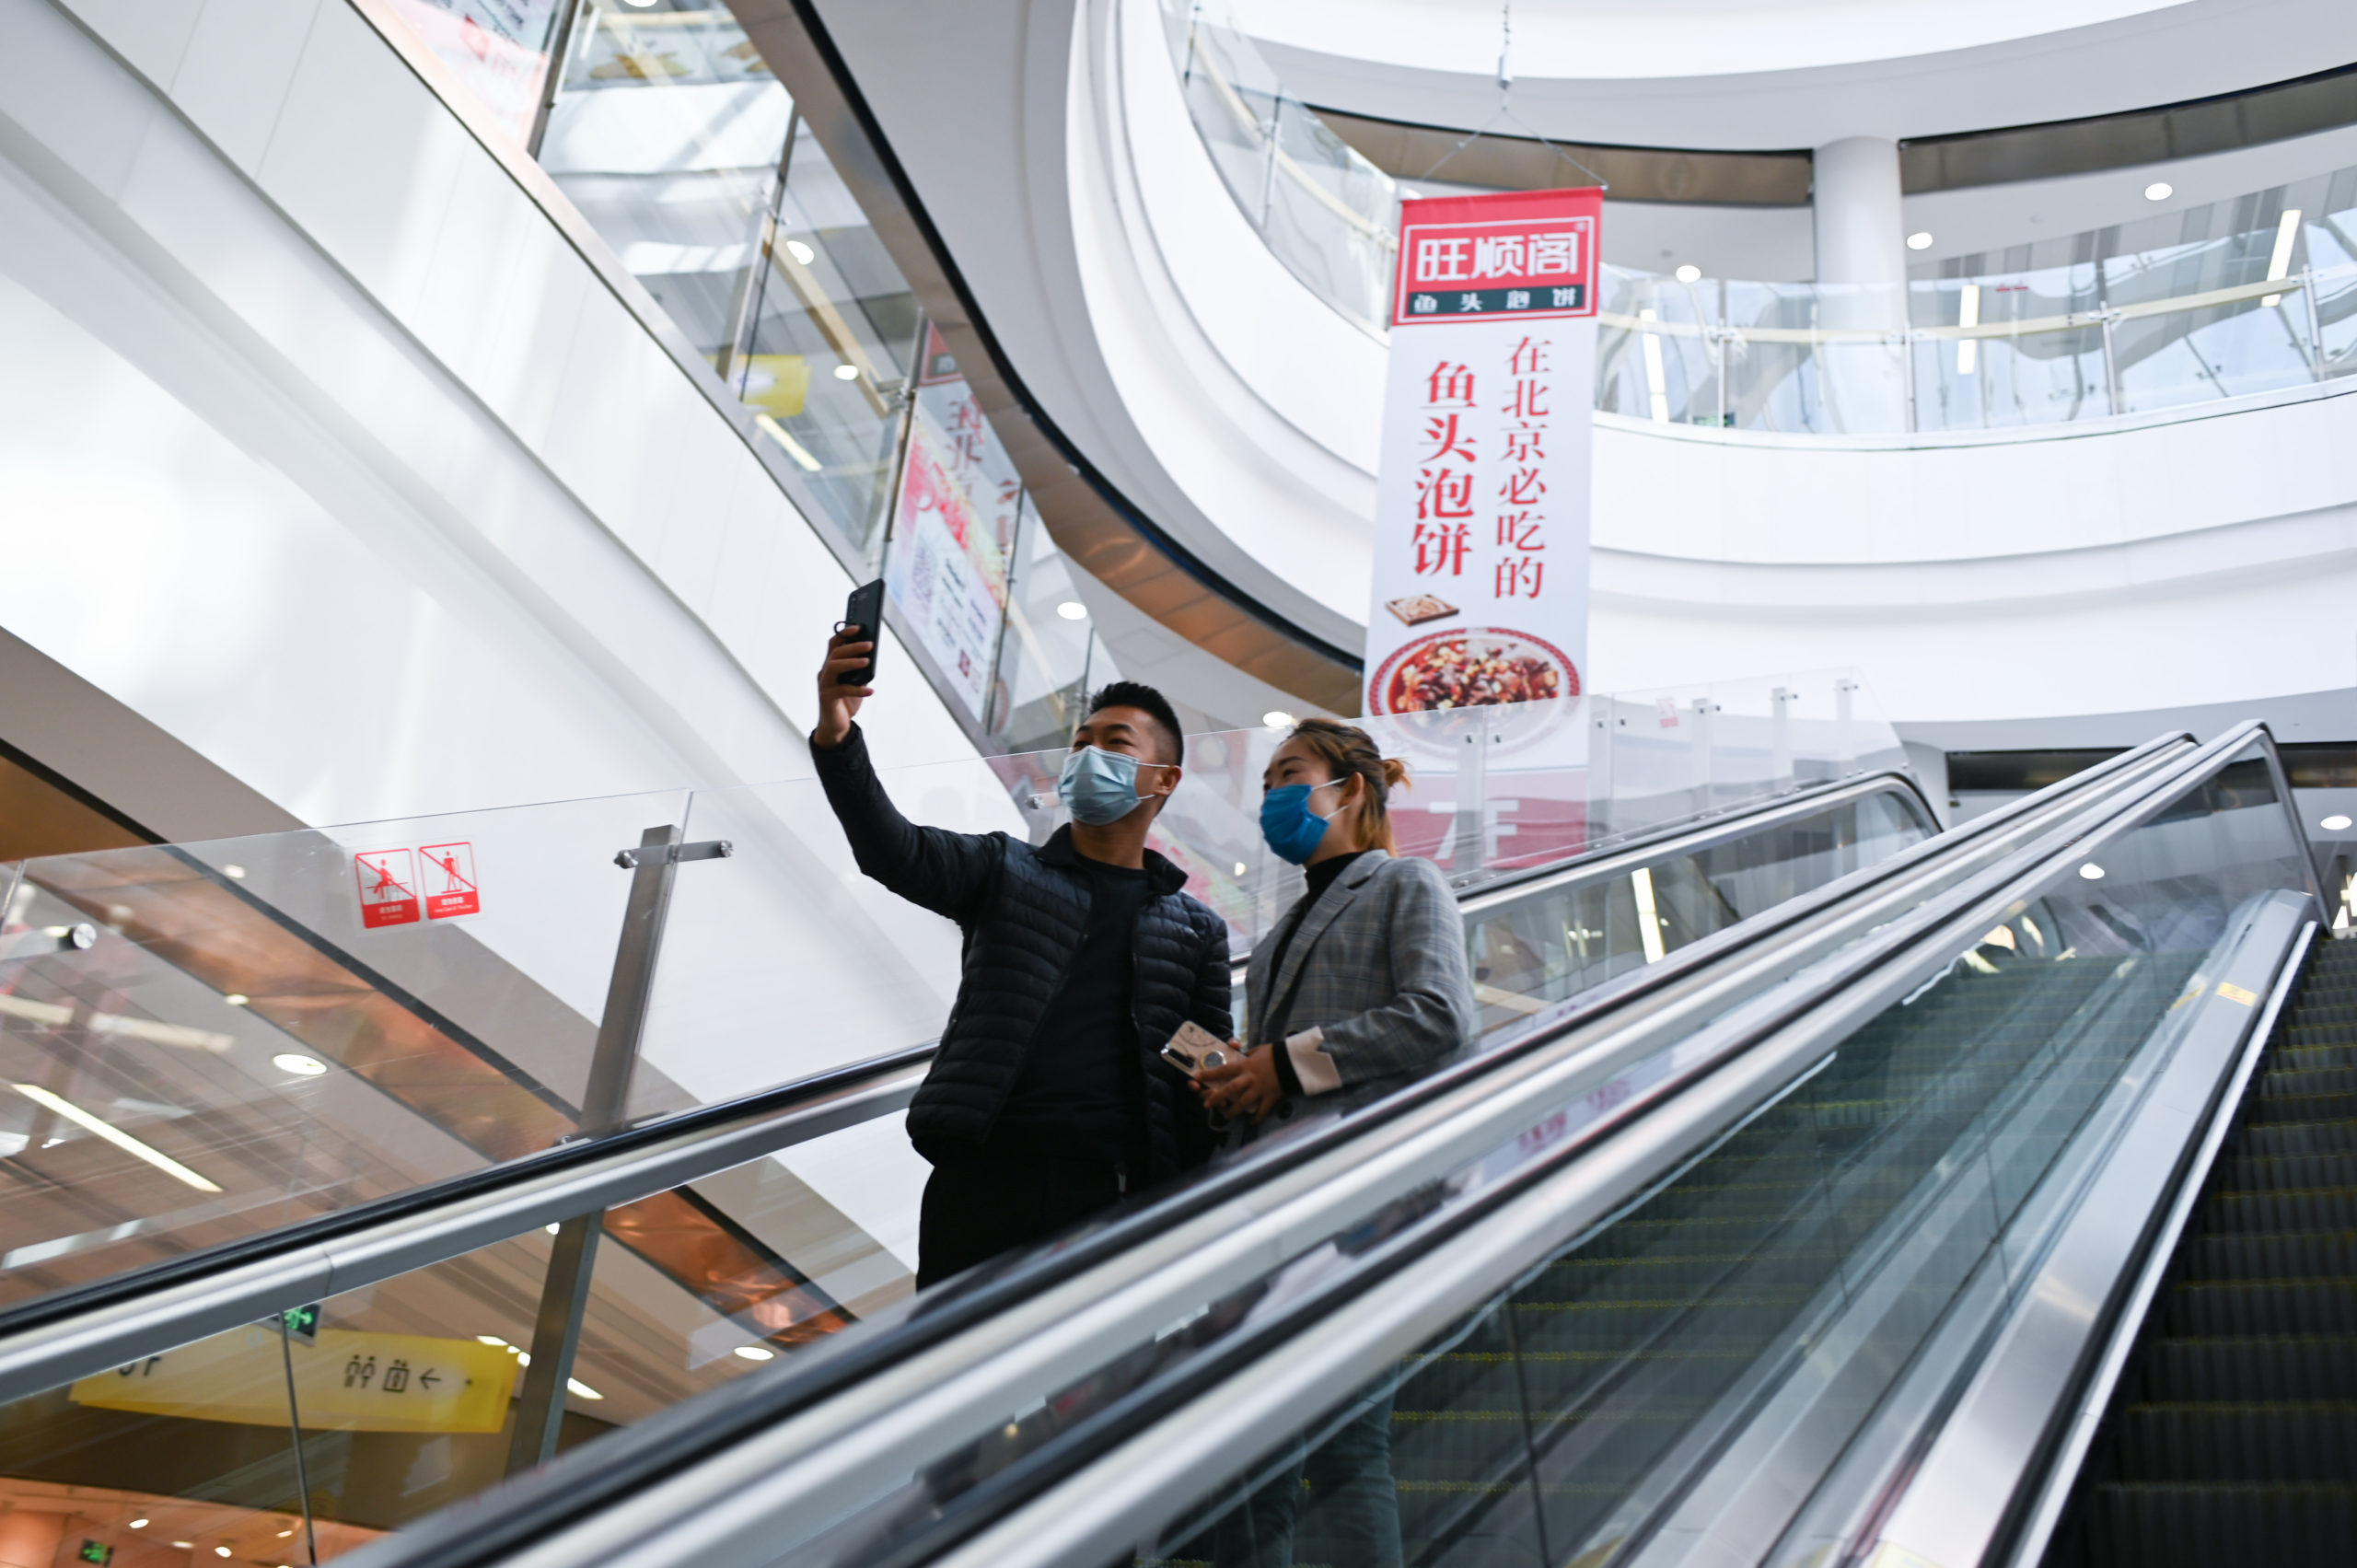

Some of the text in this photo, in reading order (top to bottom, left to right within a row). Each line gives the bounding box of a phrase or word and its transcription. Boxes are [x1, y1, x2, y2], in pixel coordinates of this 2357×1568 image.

[1415, 232, 1579, 282] 旺顺阁
[1411, 361, 1478, 576] 鱼头泡饼
[1495, 336, 1552, 599] 在北京必吃的
